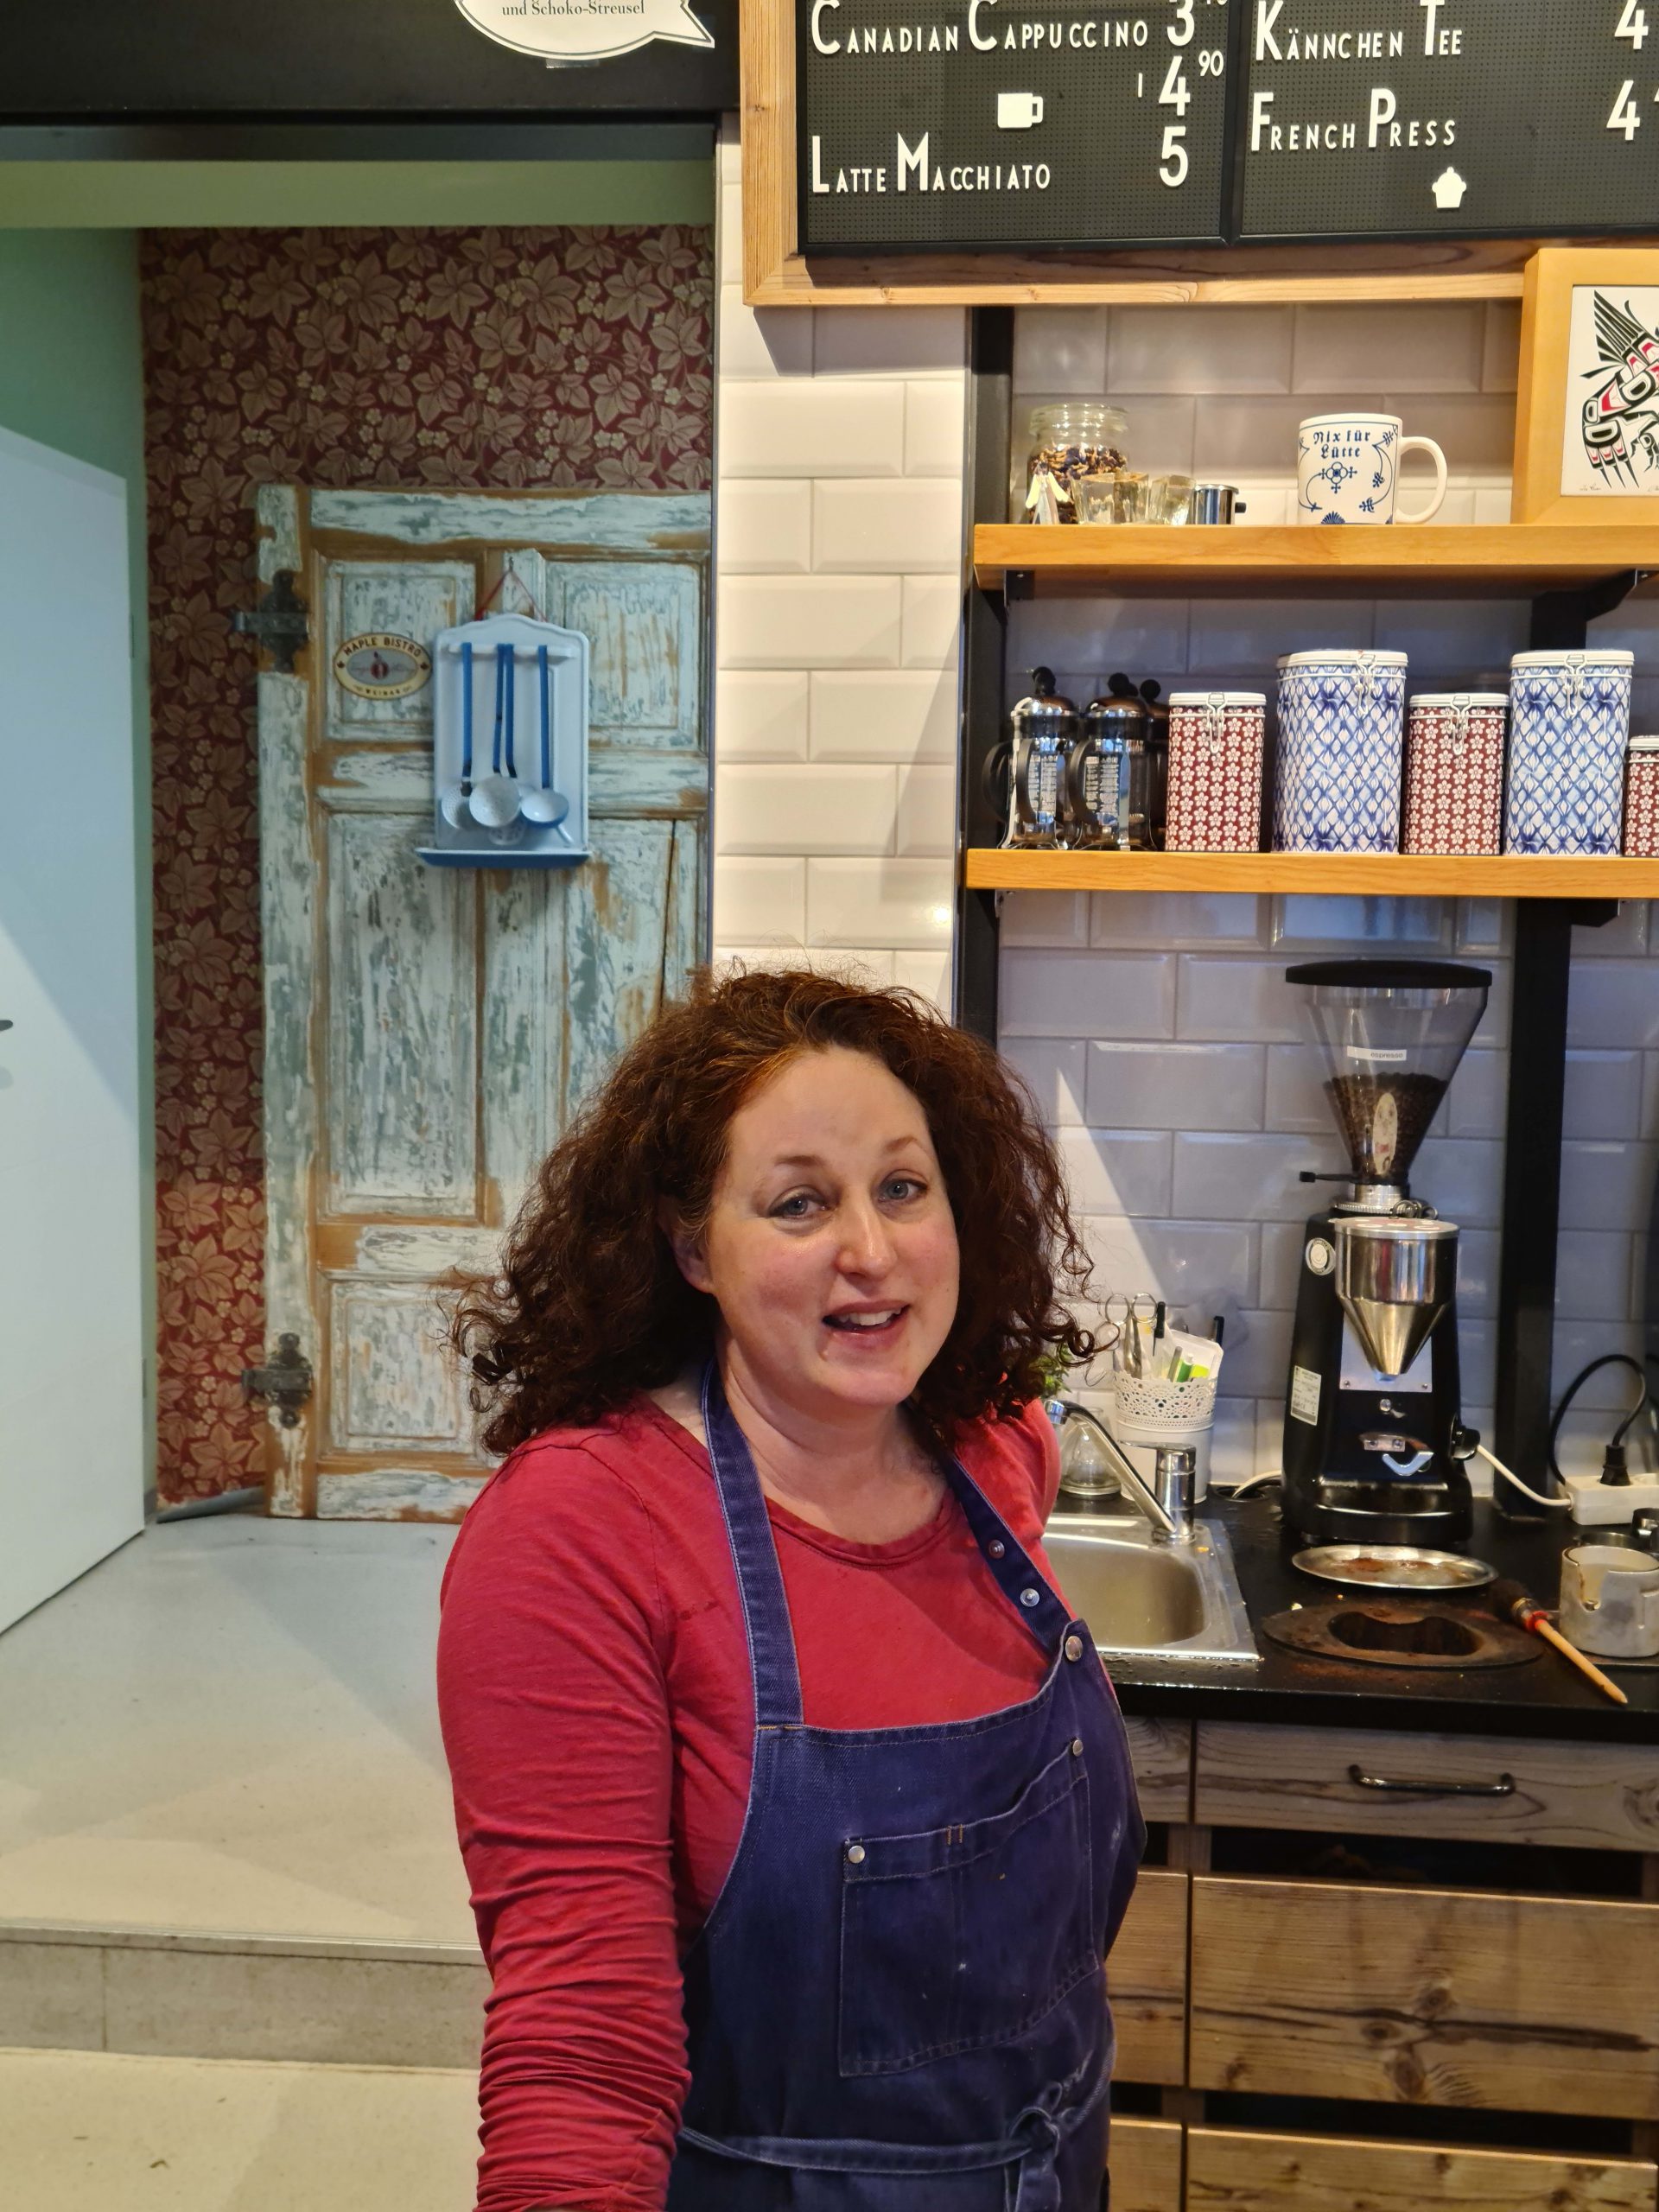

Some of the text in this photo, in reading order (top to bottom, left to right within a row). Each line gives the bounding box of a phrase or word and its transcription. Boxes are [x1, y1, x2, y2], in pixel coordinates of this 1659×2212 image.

[501, 0, 645, 16] und Schoko-Streusel
[811, 0, 958, 54] CANADIAN
[968, 0, 1148, 52] CAPPUCCINO
[1419, 0, 1463, 56] TEE
[1614, 0, 1649, 50] 4
[1250, 79, 1641, 151] FRENCH PRESS 4
[811, 125, 1189, 194] LATTE MACCHIATO 5
[344, 637, 422, 658] MAPLE BISTRO
